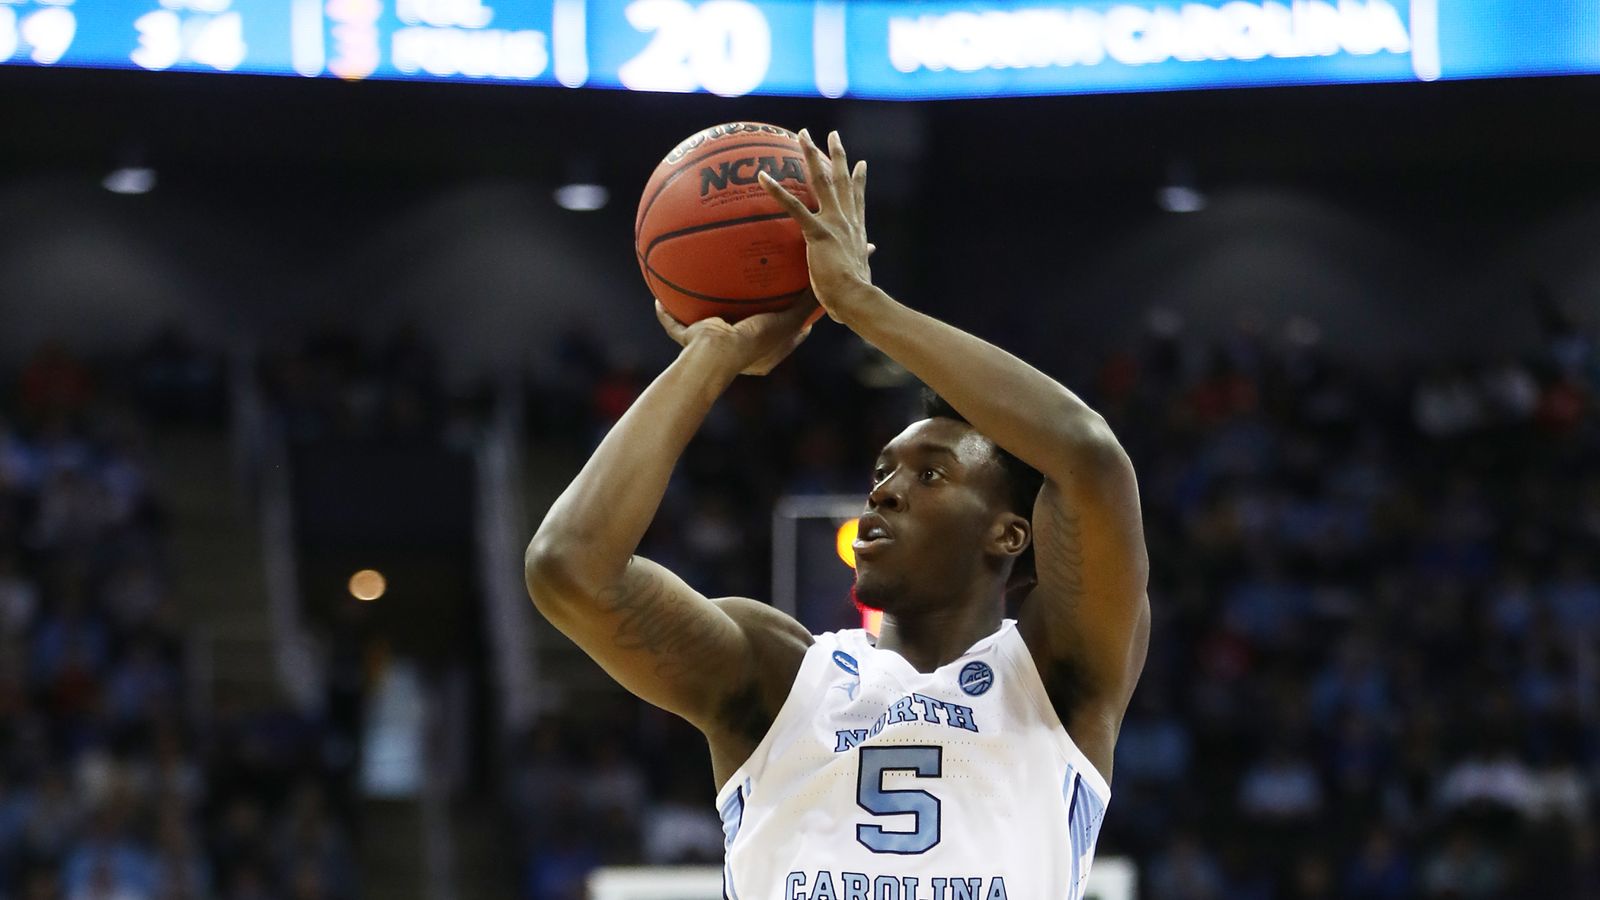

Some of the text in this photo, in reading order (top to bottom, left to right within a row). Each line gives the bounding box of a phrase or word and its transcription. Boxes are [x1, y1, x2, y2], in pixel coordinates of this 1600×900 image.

[617, 0, 770, 97] 20
[889, 0, 1409, 71] NORTH CAROLINA
[700, 156, 805, 197] NCAA
[964, 670, 990, 684] ACC
[834, 692, 979, 752] NORTH
[856, 744, 943, 855] 5
